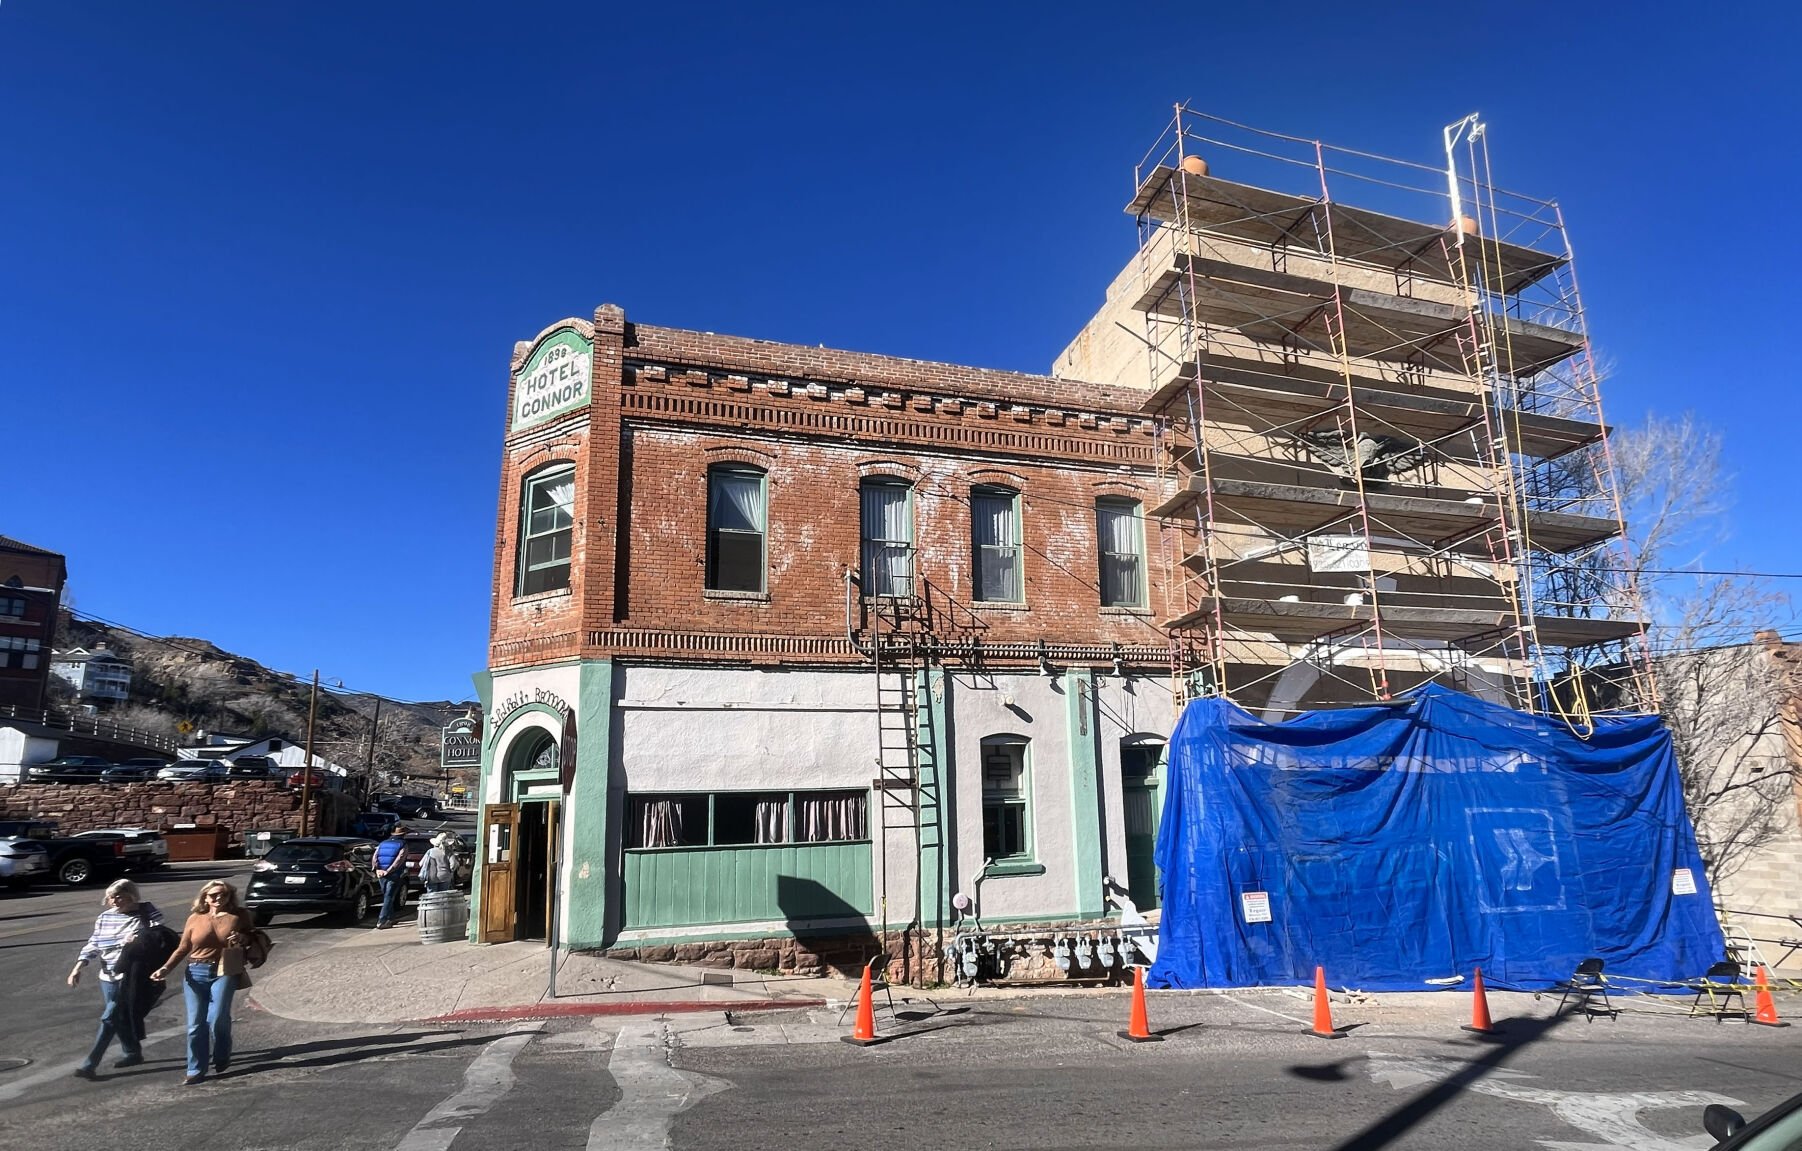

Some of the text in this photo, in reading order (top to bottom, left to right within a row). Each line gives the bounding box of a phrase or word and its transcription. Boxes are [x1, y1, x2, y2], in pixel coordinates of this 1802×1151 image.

[527, 360, 580, 396] HOTEL
[522, 380, 583, 418] CONNOR
[447, 748, 478, 757] HOTEL
